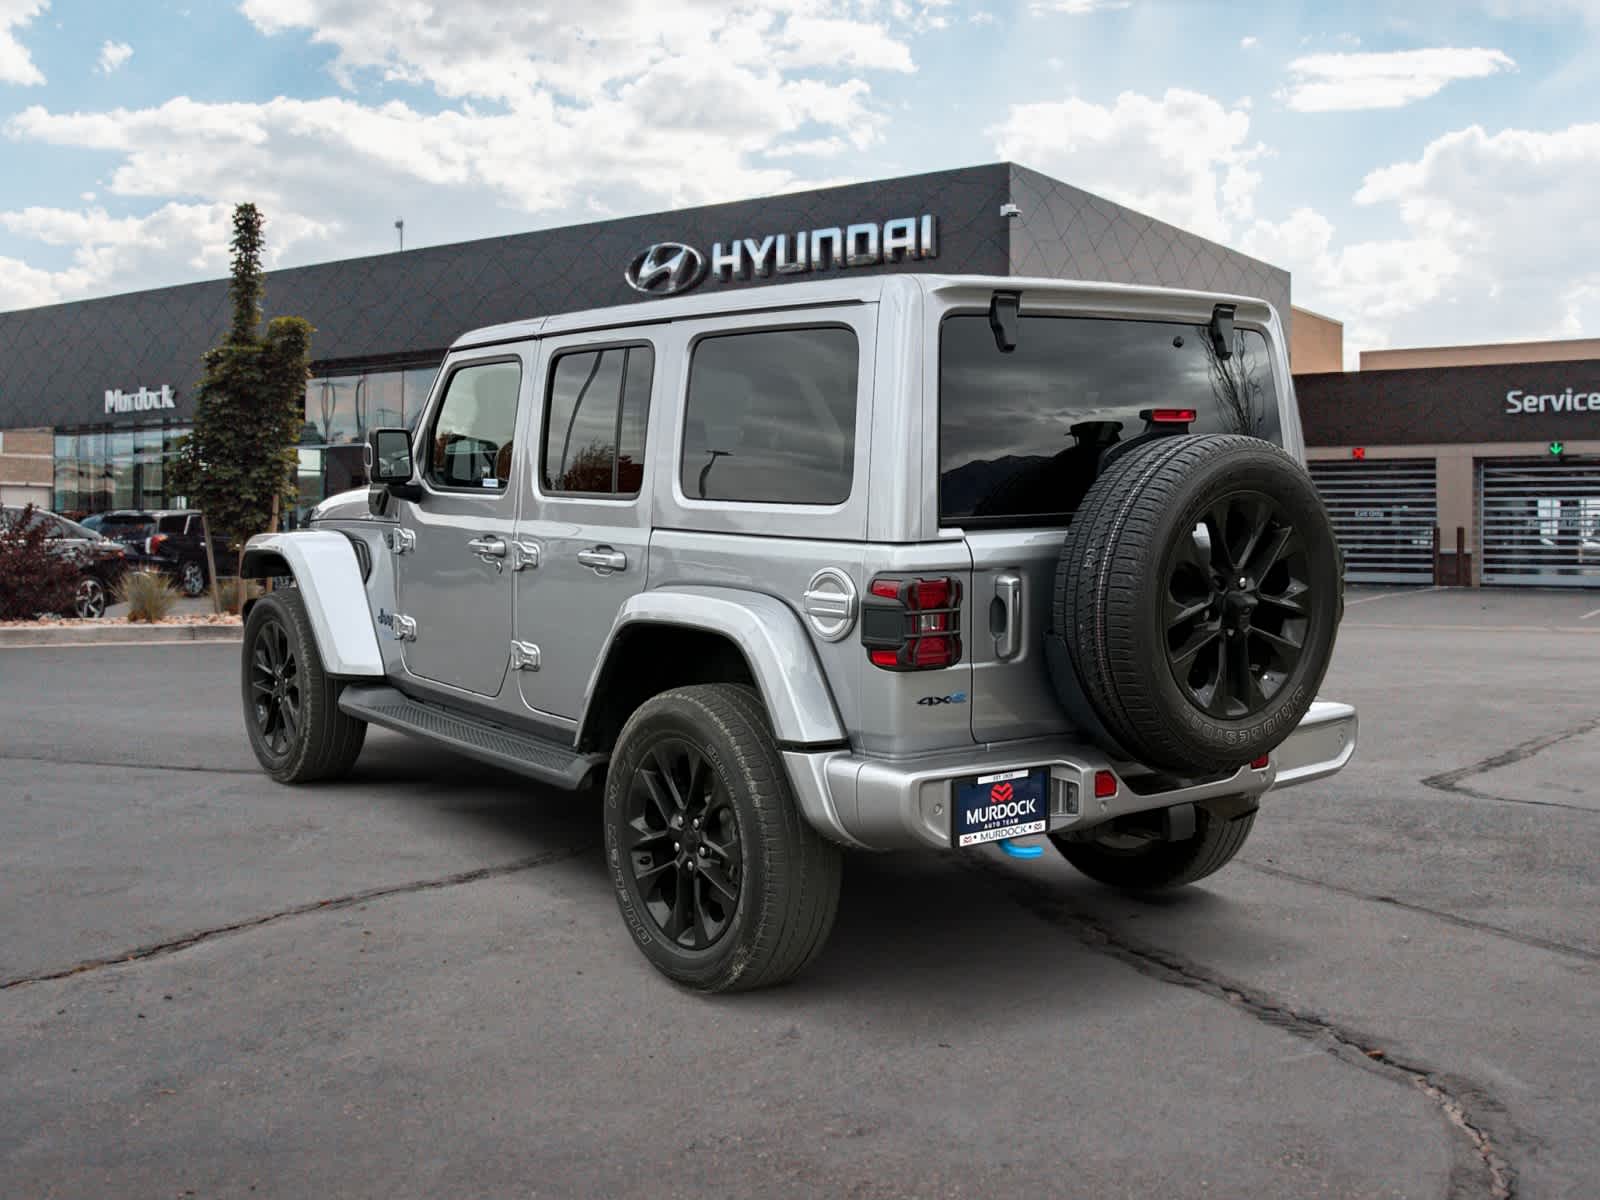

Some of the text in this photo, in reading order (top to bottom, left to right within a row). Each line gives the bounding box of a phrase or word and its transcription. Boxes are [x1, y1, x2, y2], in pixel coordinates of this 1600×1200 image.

[712, 214, 937, 283] HYUNDAI
[104, 384, 176, 414] Murdock
[1506, 387, 1600, 414] Service
[966, 798, 1037, 825] MURDOCK
[984, 817, 1019, 829] AUTO TEAM
[980, 824, 1028, 841] MURDOCK
